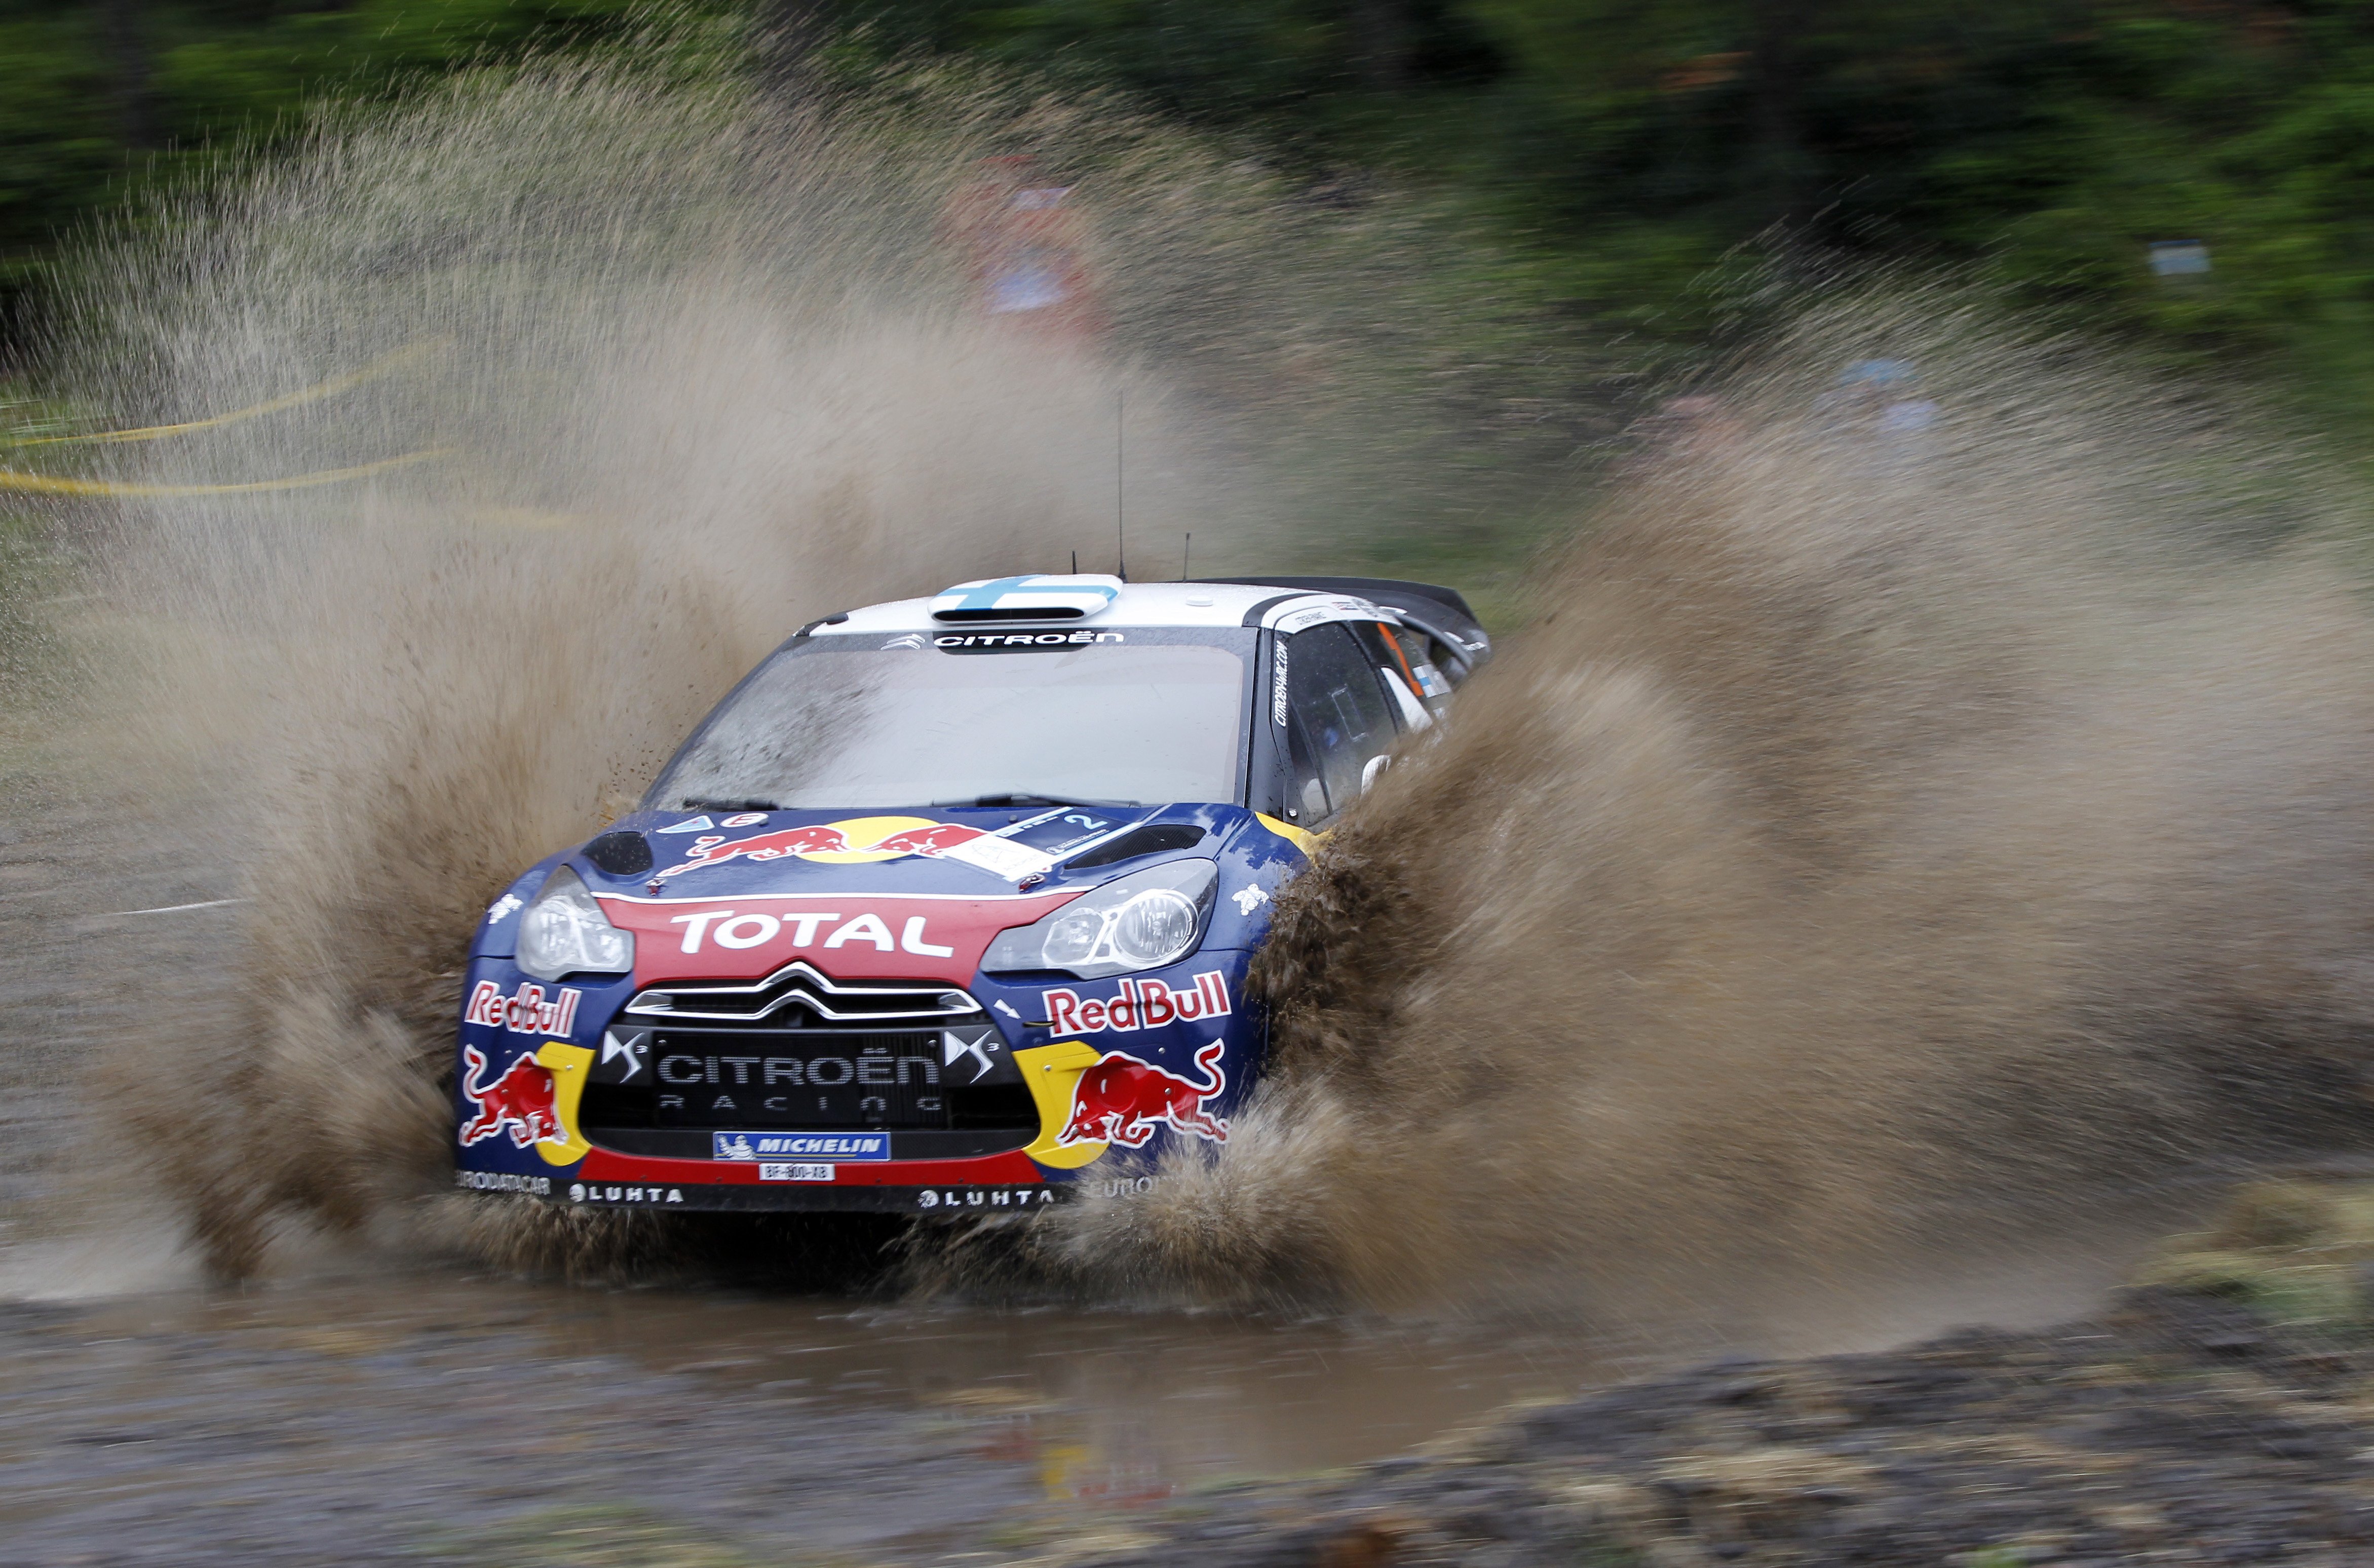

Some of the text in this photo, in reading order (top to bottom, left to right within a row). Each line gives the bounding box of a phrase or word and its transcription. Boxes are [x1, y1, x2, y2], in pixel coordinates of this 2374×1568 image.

[729, 814, 760, 825] E
[1064, 814, 1108, 830] 2
[670, 910, 954, 958] TOTAL
[756, 1138, 882, 1153] MICHELIN
[589, 1186, 684, 1203] LUHTA
[945, 1189, 1055, 1206] LUHTA
